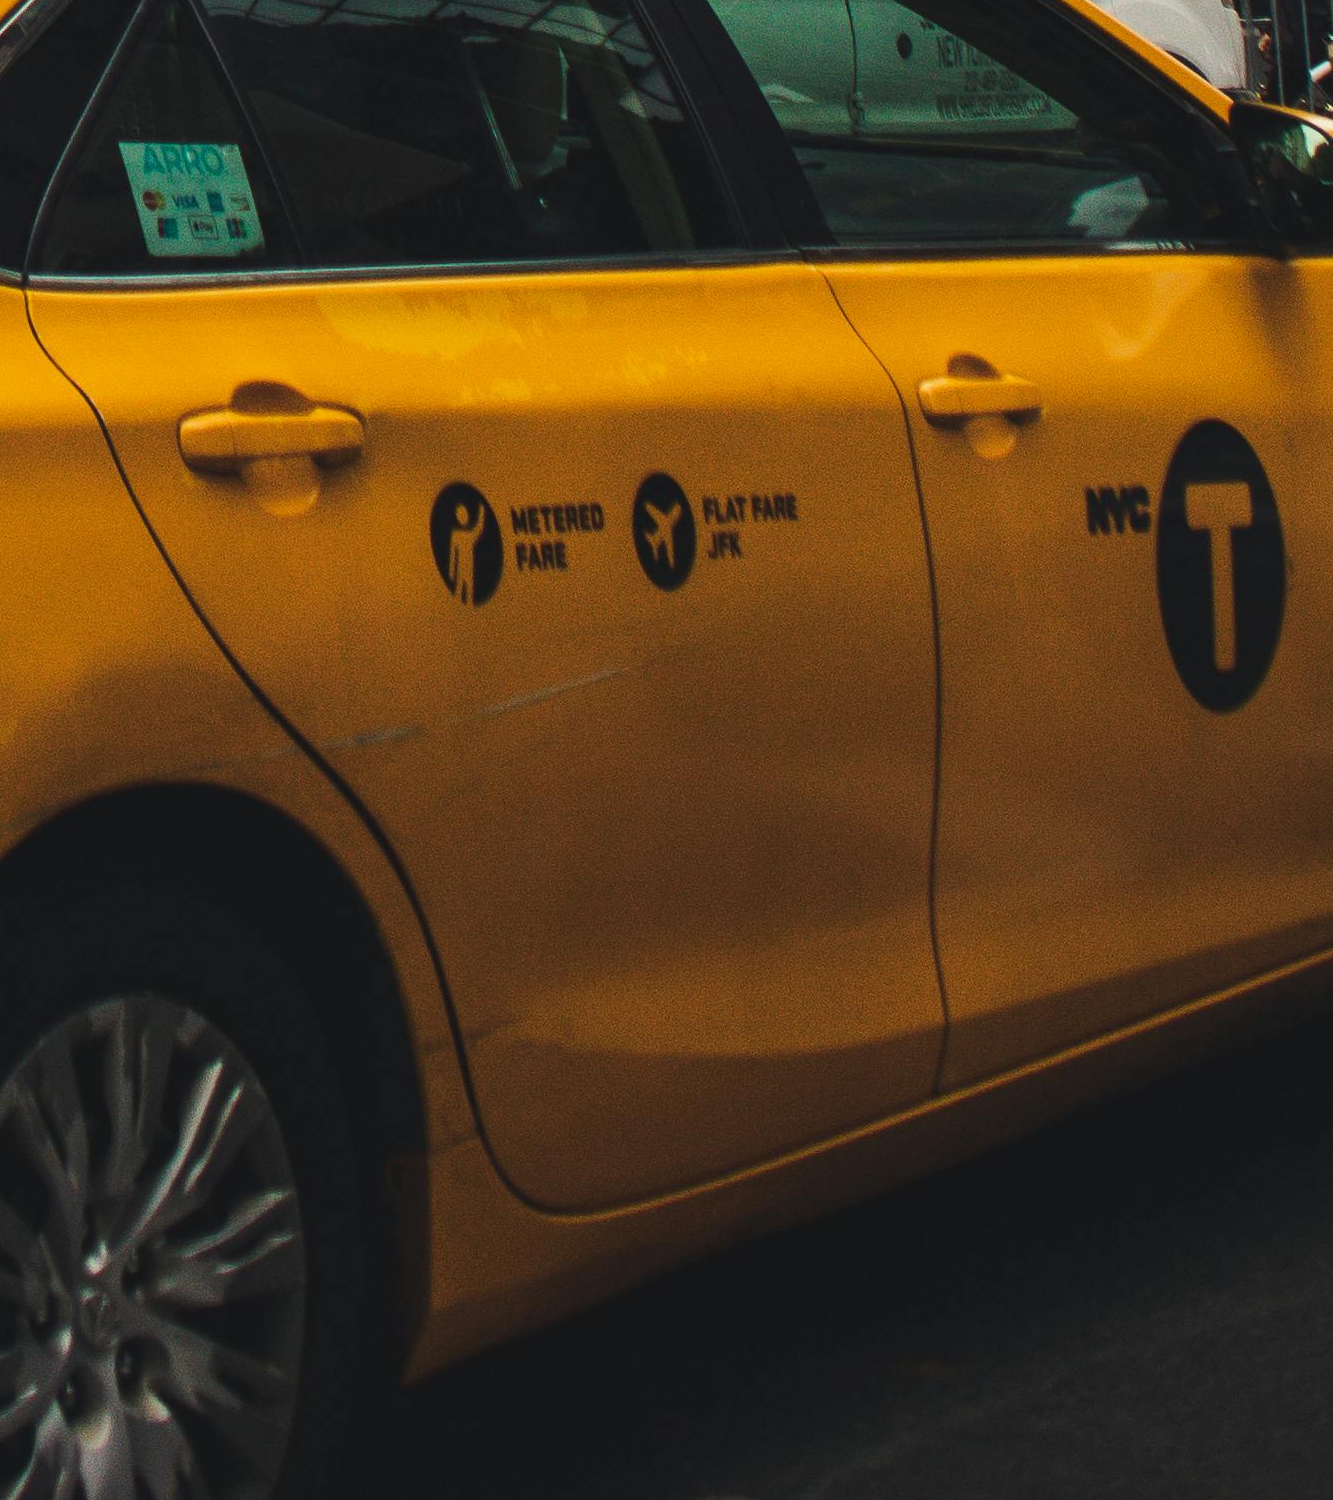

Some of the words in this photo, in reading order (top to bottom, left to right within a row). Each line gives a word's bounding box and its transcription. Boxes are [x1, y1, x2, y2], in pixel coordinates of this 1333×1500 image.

[143, 145, 225, 175] ARRO
[172, 193, 200, 209] VISA
[510, 503, 605, 534] METERED
[704, 496, 747, 524] FLAT
[751, 493, 798, 522] FARE
[516, 541, 568, 571] FARE
[708, 531, 742, 560] JFK
[1084, 484, 1151, 535] NYC
[1185, 482, 1253, 672] T
